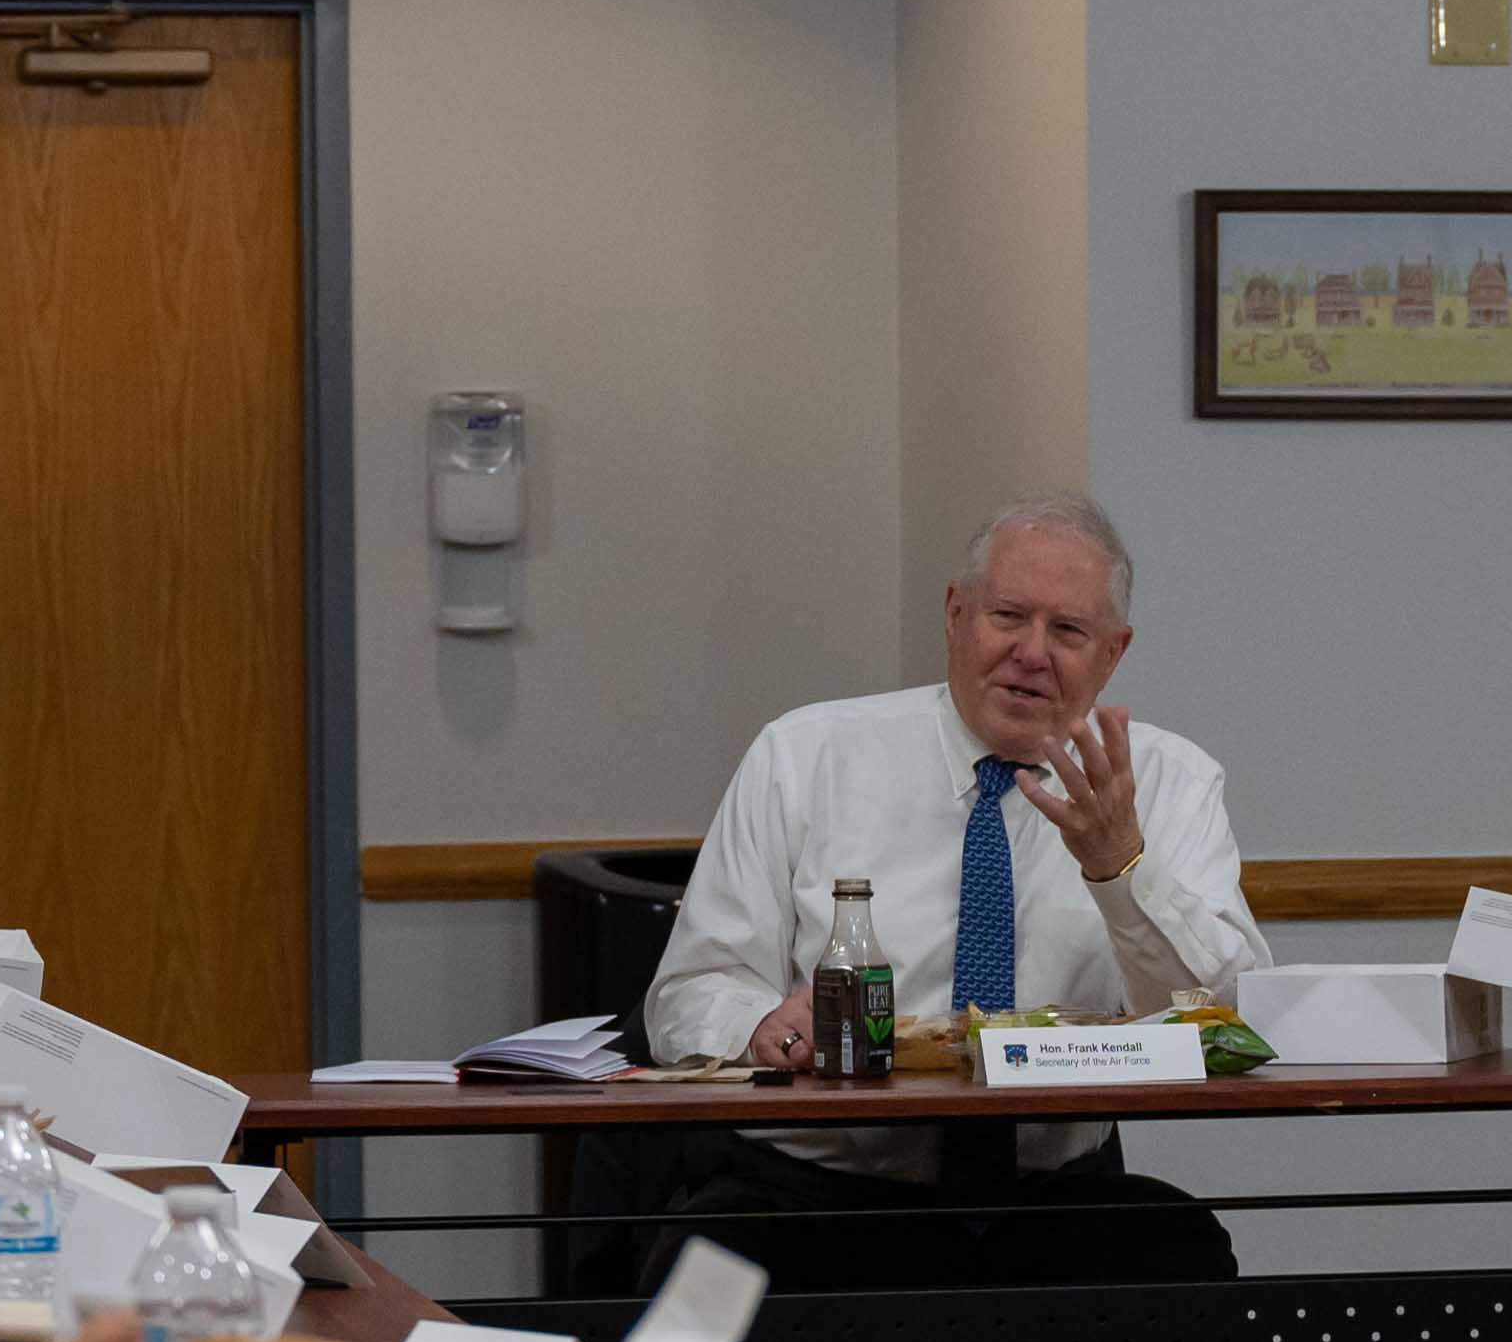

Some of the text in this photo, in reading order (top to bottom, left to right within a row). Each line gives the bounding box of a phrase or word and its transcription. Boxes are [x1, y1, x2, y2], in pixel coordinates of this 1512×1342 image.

[868, 985, 888, 995] PURE
[868, 995, 888, 1009] LEAF
[1039, 1042, 1143, 1054] Hon. Frank Kendall
[1035, 1055, 1151, 1068] Secretary of the Air Force
